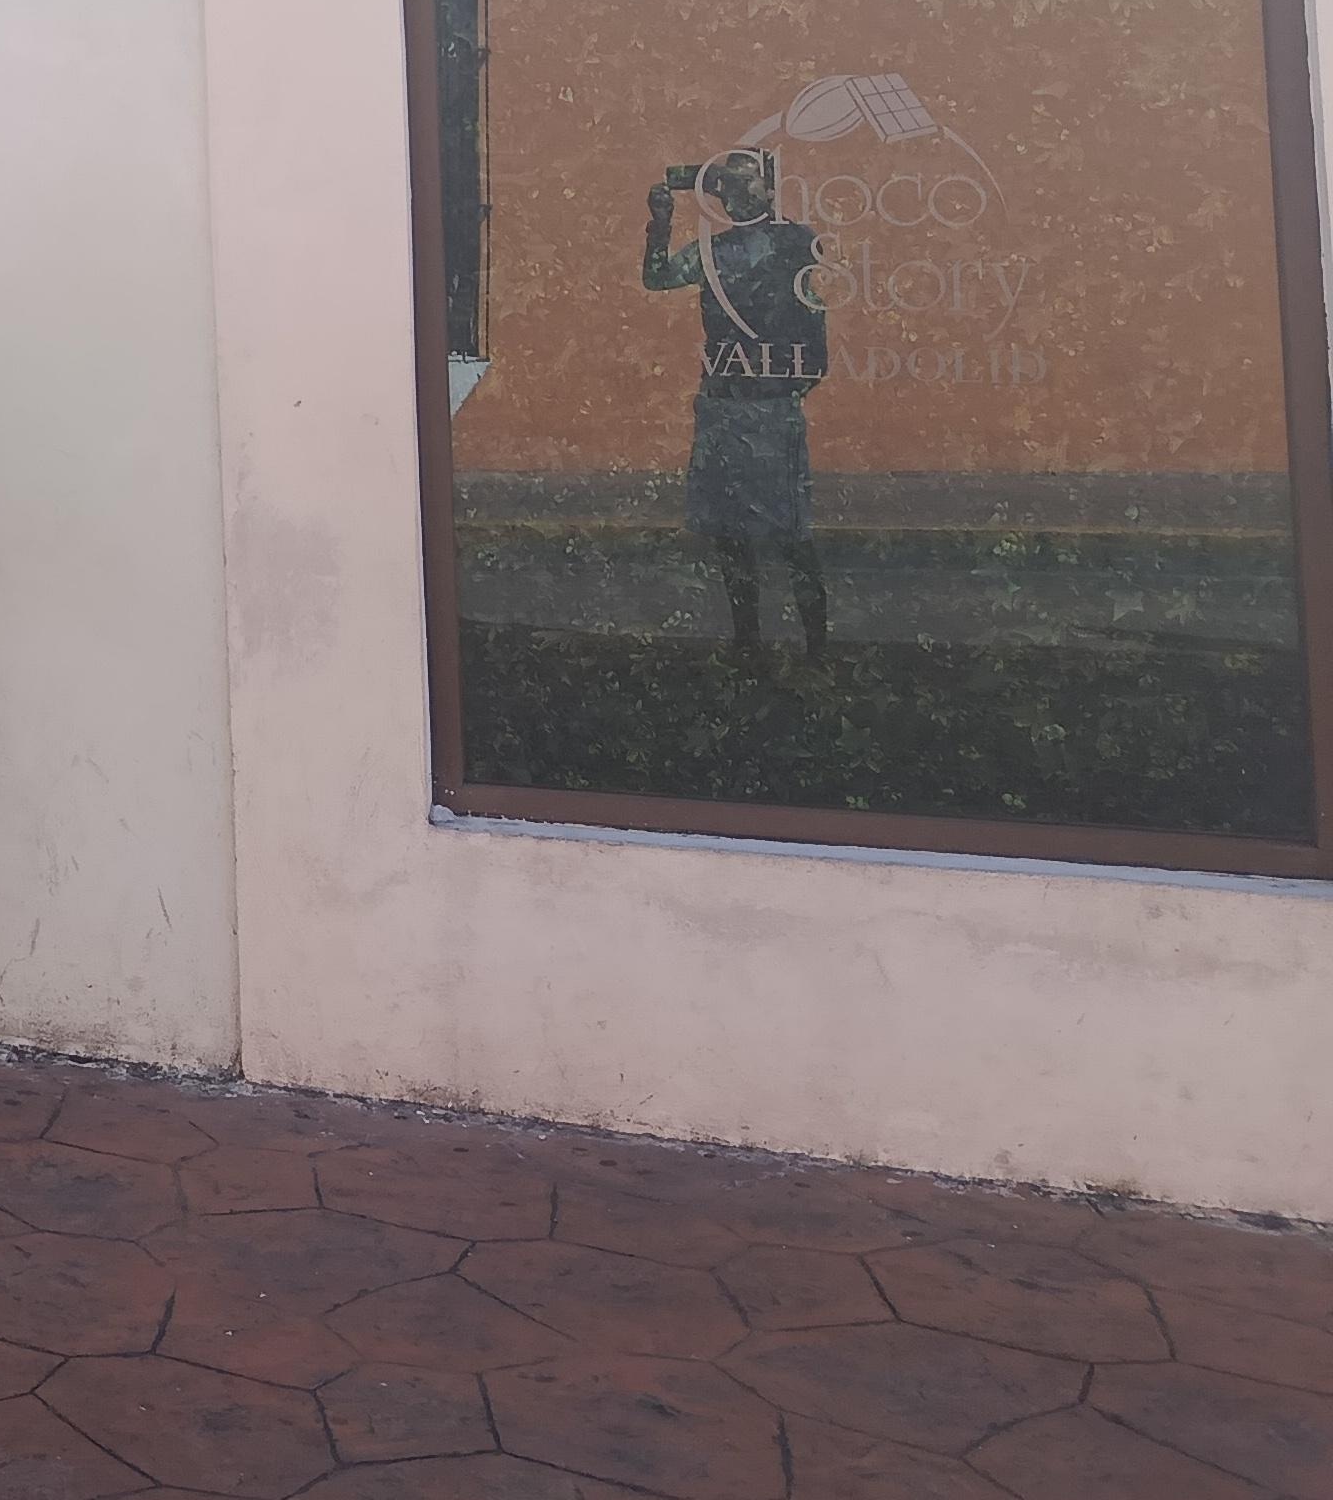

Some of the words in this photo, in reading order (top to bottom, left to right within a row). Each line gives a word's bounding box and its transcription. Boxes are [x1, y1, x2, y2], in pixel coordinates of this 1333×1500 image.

[694, 145, 988, 228] Choco
[793, 232, 1032, 342] Story
[695, 342, 1048, 385] VALLADOLID
